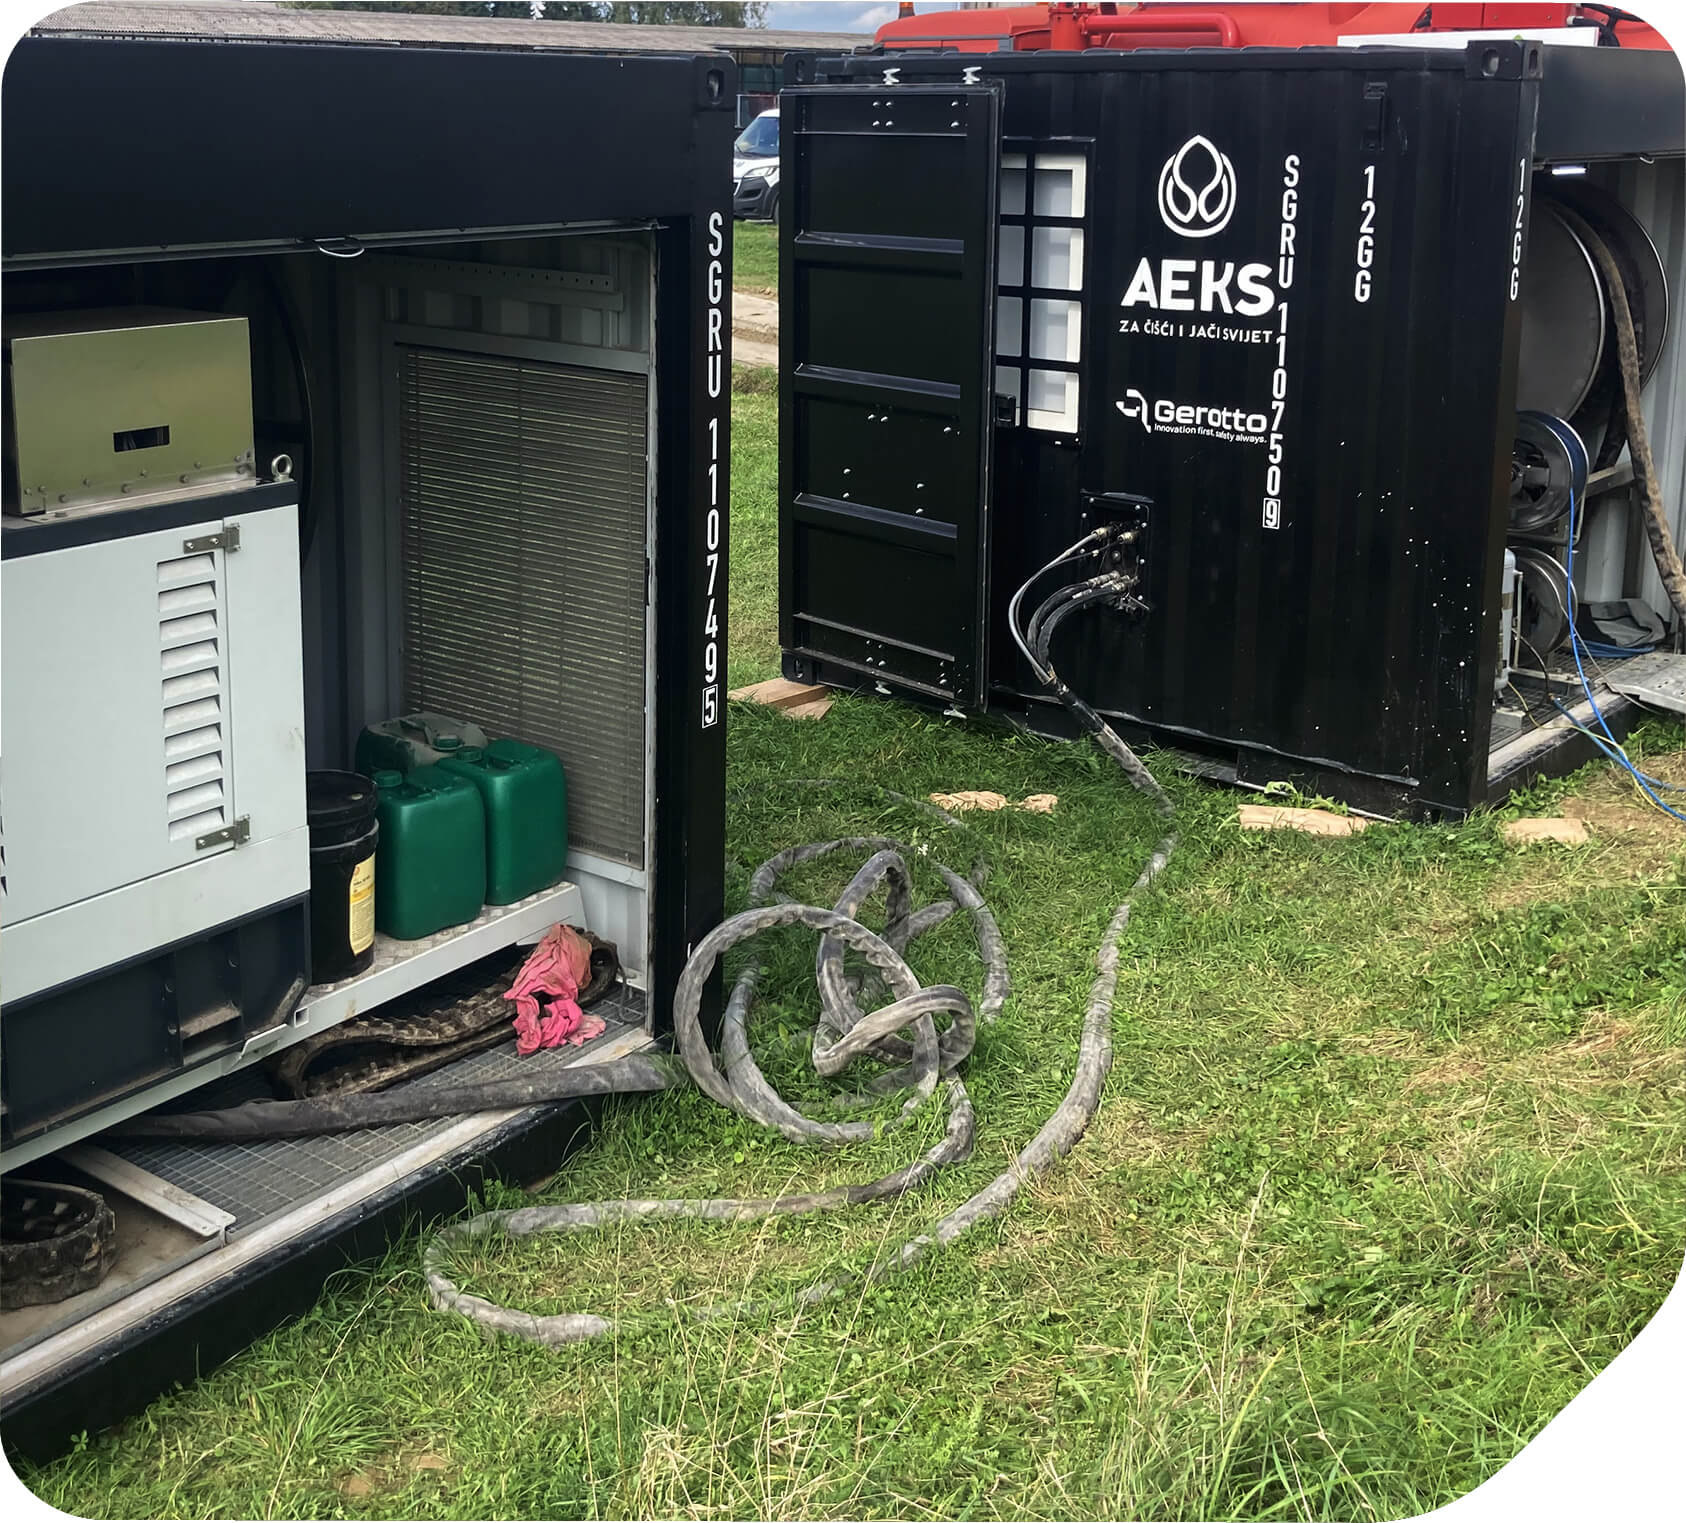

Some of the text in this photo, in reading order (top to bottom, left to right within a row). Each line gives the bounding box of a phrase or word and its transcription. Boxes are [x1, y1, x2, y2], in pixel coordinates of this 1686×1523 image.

[1278, 154, 1300, 289] SGRU
[1354, 165, 1376, 303] 12GG
[1510, 158, 1526, 301] 12GG
[708, 211, 723, 398] SGRU
[1118, 318, 1273, 344] ZA ČIŠĆI I JAČI SVIJET
[1120, 256, 1275, 317] AEKS
[1154, 399, 1268, 433] Gerotto
[1154, 423, 1197, 435] Innovation
